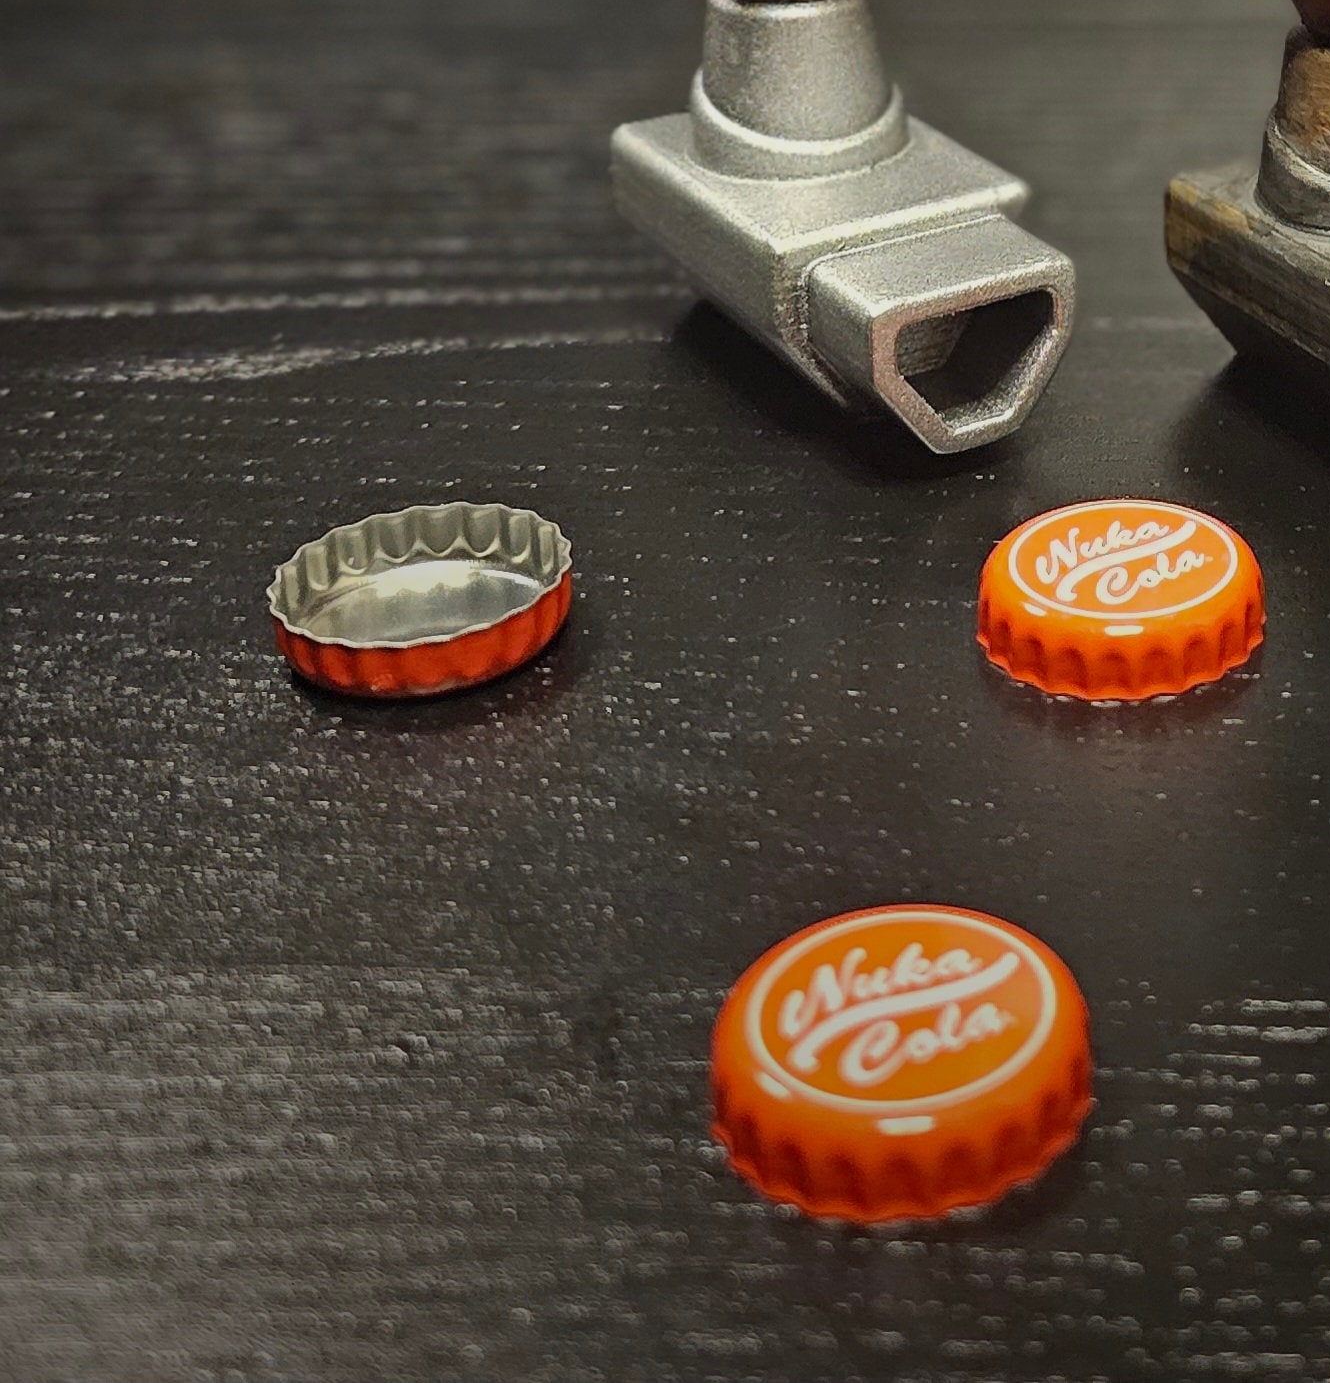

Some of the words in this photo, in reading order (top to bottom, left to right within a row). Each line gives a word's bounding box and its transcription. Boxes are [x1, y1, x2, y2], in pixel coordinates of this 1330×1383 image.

[1035, 520, 1170, 585] Nuka
[1095, 549, 1205, 606] Cola
[778, 942, 983, 1040] Nuka
[838, 1002, 1007, 1088] Cola
